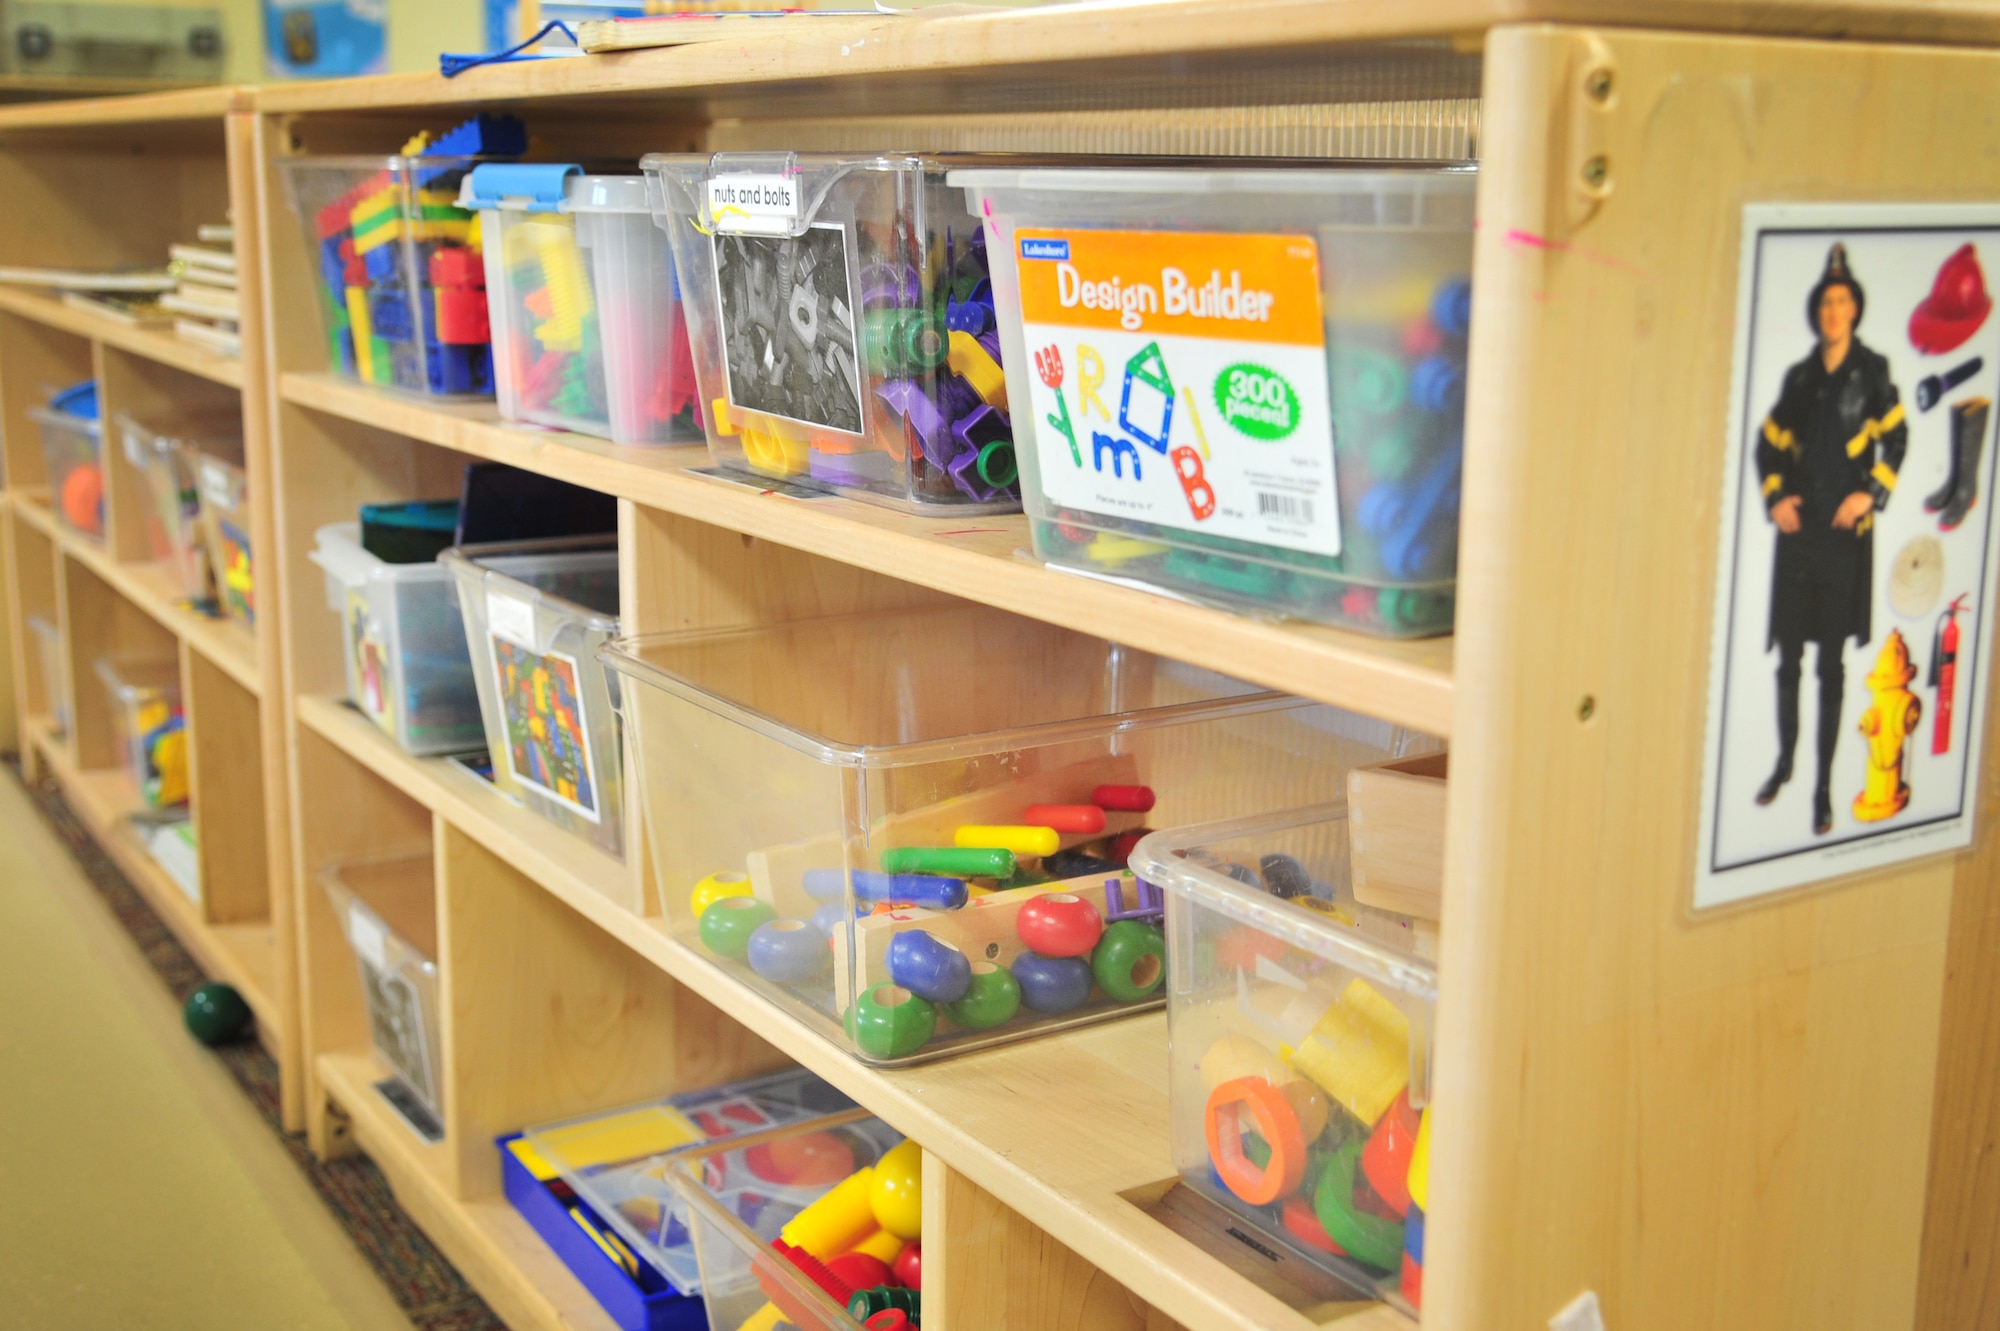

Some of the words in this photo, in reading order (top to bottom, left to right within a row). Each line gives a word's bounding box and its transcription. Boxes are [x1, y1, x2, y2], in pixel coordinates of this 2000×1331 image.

[714, 184, 736, 203] nuts
[739, 184, 761, 204] and
[764, 185, 790, 206] bolts
[1056, 262, 1158, 330] Design
[1161, 266, 1274, 322] Builder
[1077, 344, 1110, 421] R
[1229, 370, 1287, 407] 300
[1225, 396, 1290, 427] pieces!
[1092, 430, 1142, 481] m
[1170, 445, 1216, 521] B
